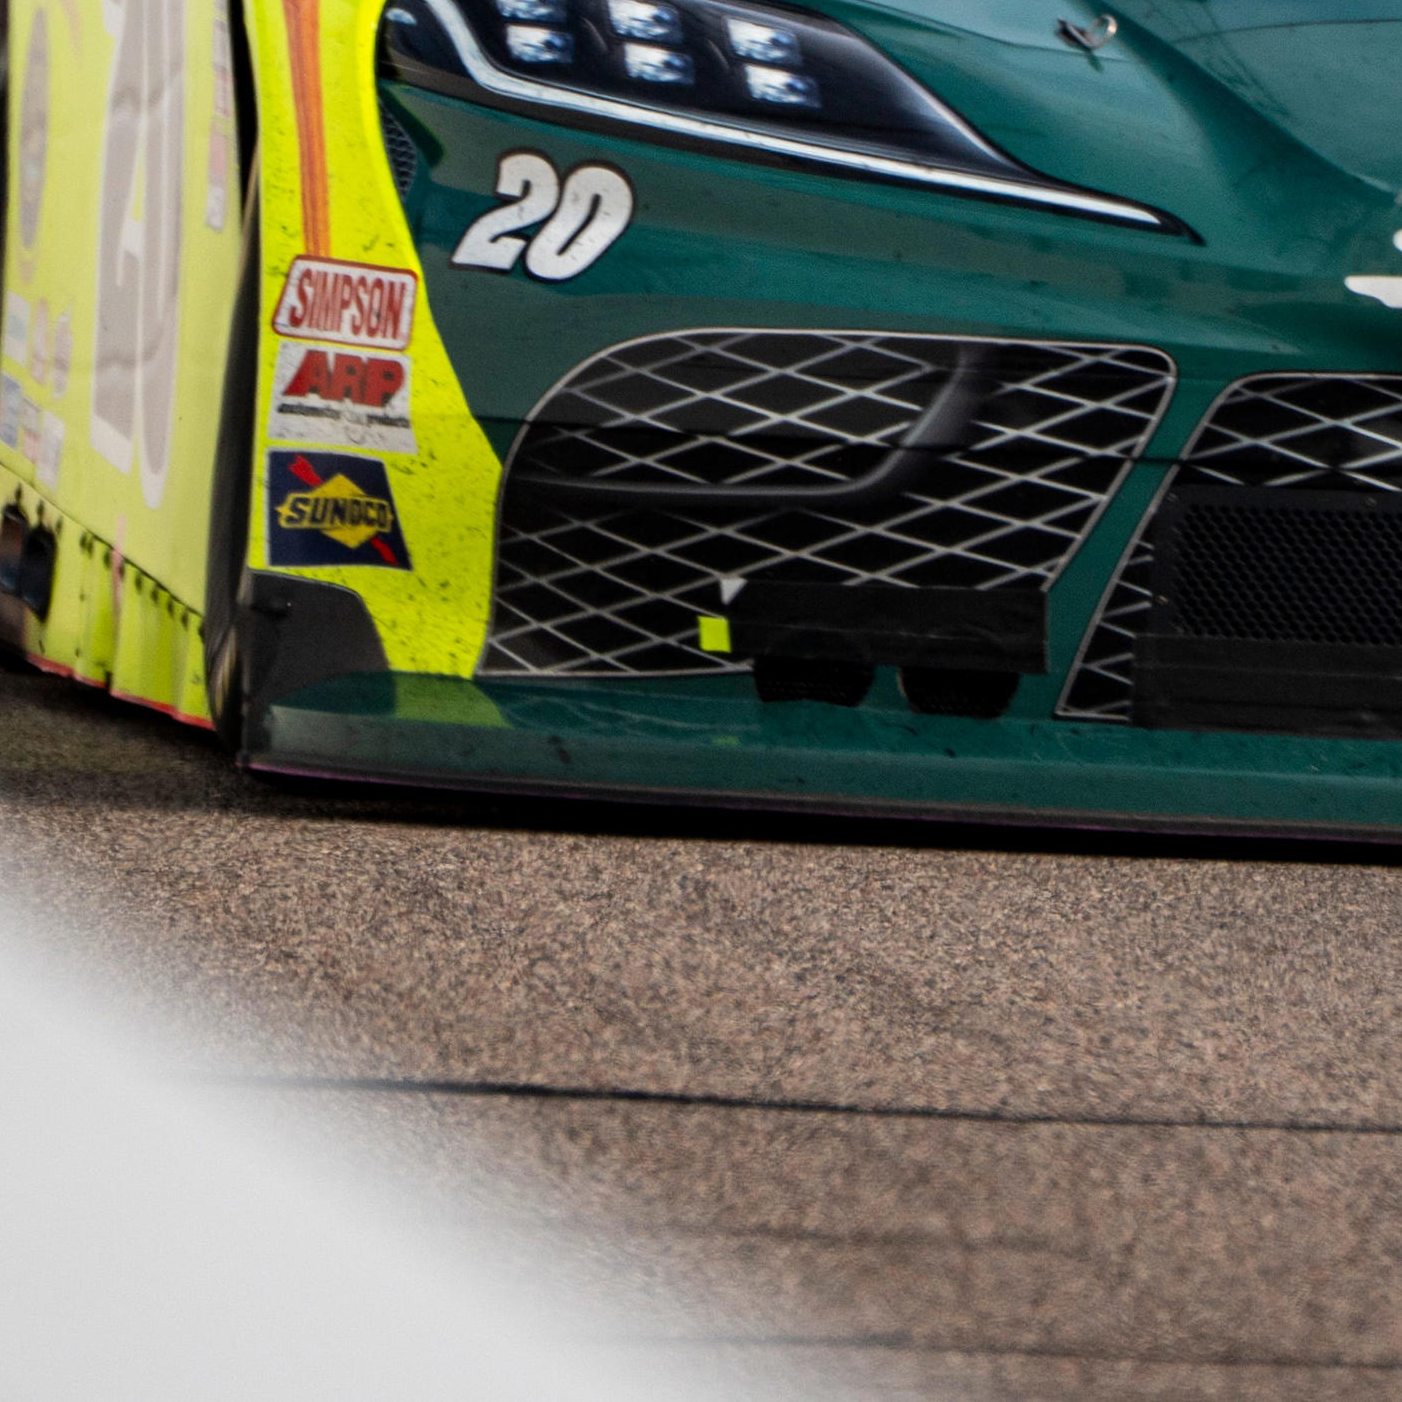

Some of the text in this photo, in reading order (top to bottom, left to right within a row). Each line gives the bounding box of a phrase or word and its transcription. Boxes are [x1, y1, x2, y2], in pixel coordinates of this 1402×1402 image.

[451, 150, 633, 282] 20
[289, 270, 406, 340] SIMPSON
[282, 350, 405, 407] ARP
[285, 495, 391, 532] SUNOCO
